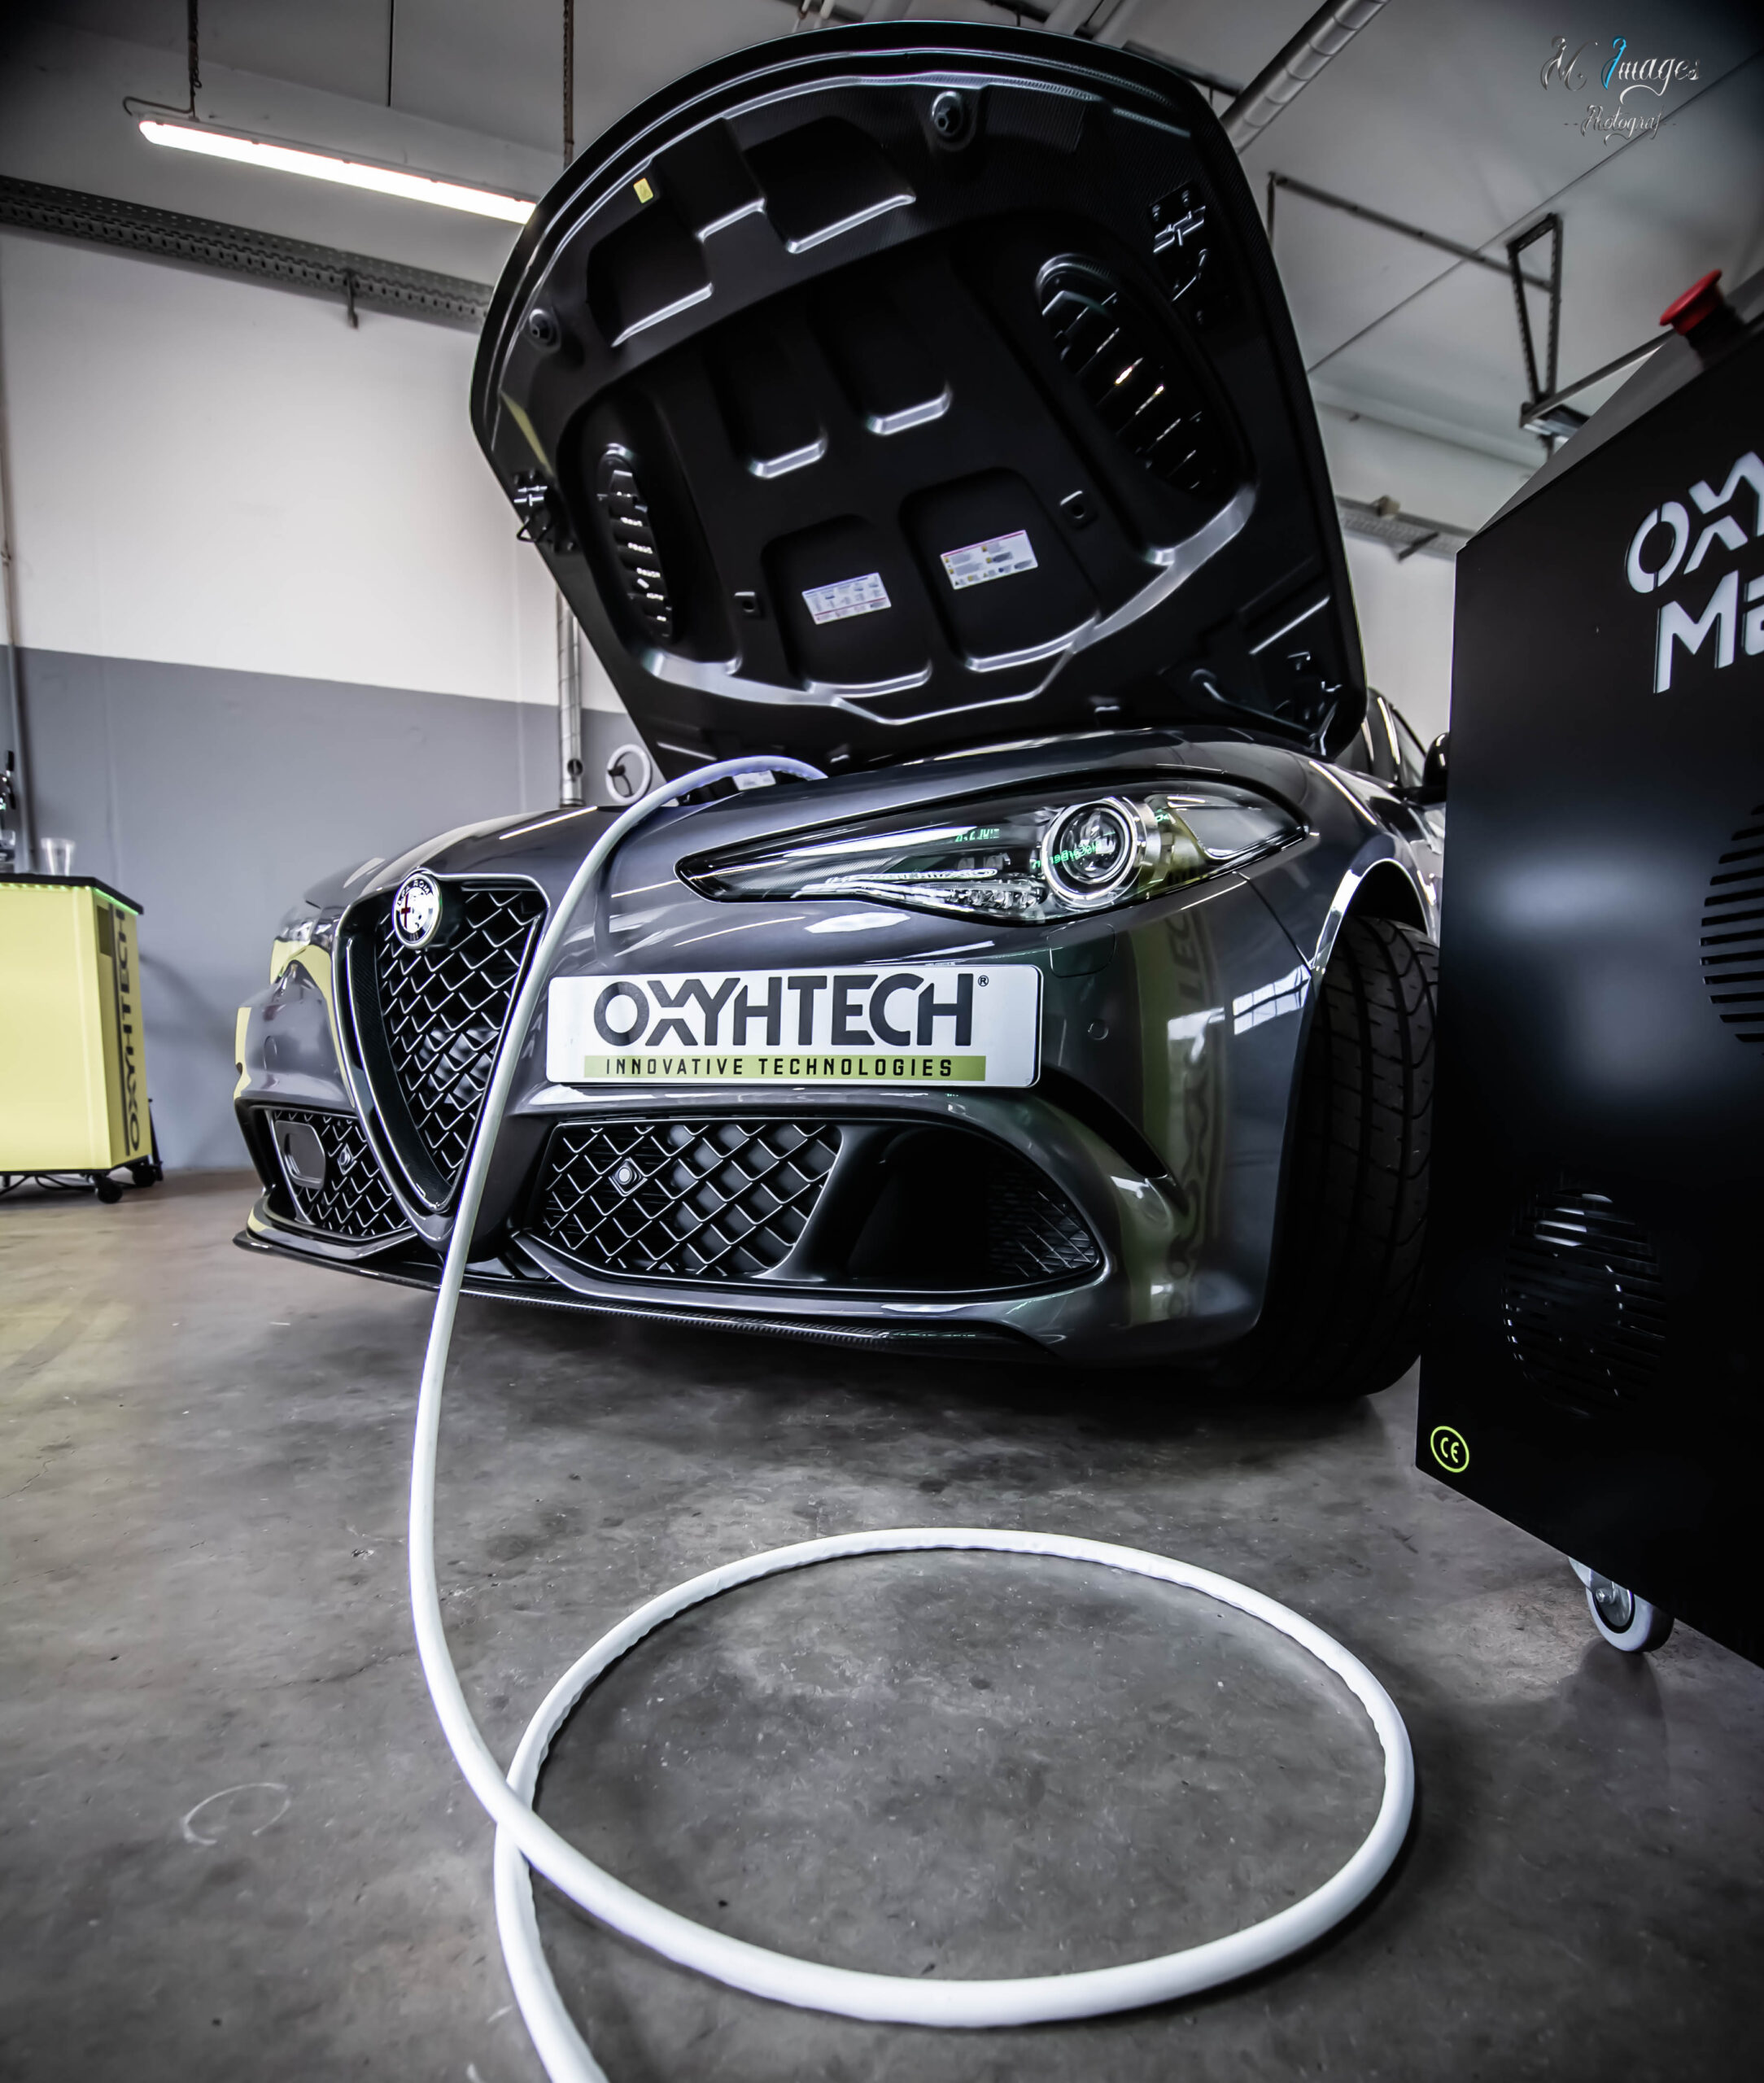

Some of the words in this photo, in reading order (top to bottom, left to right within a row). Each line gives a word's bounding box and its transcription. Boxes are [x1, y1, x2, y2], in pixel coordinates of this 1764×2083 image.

[115, 909, 140, 1151] OXYHTECH
[605, 1059, 744, 1076] INNOVATIVE
[758, 1058, 953, 1077] TECHNOLOGIES
